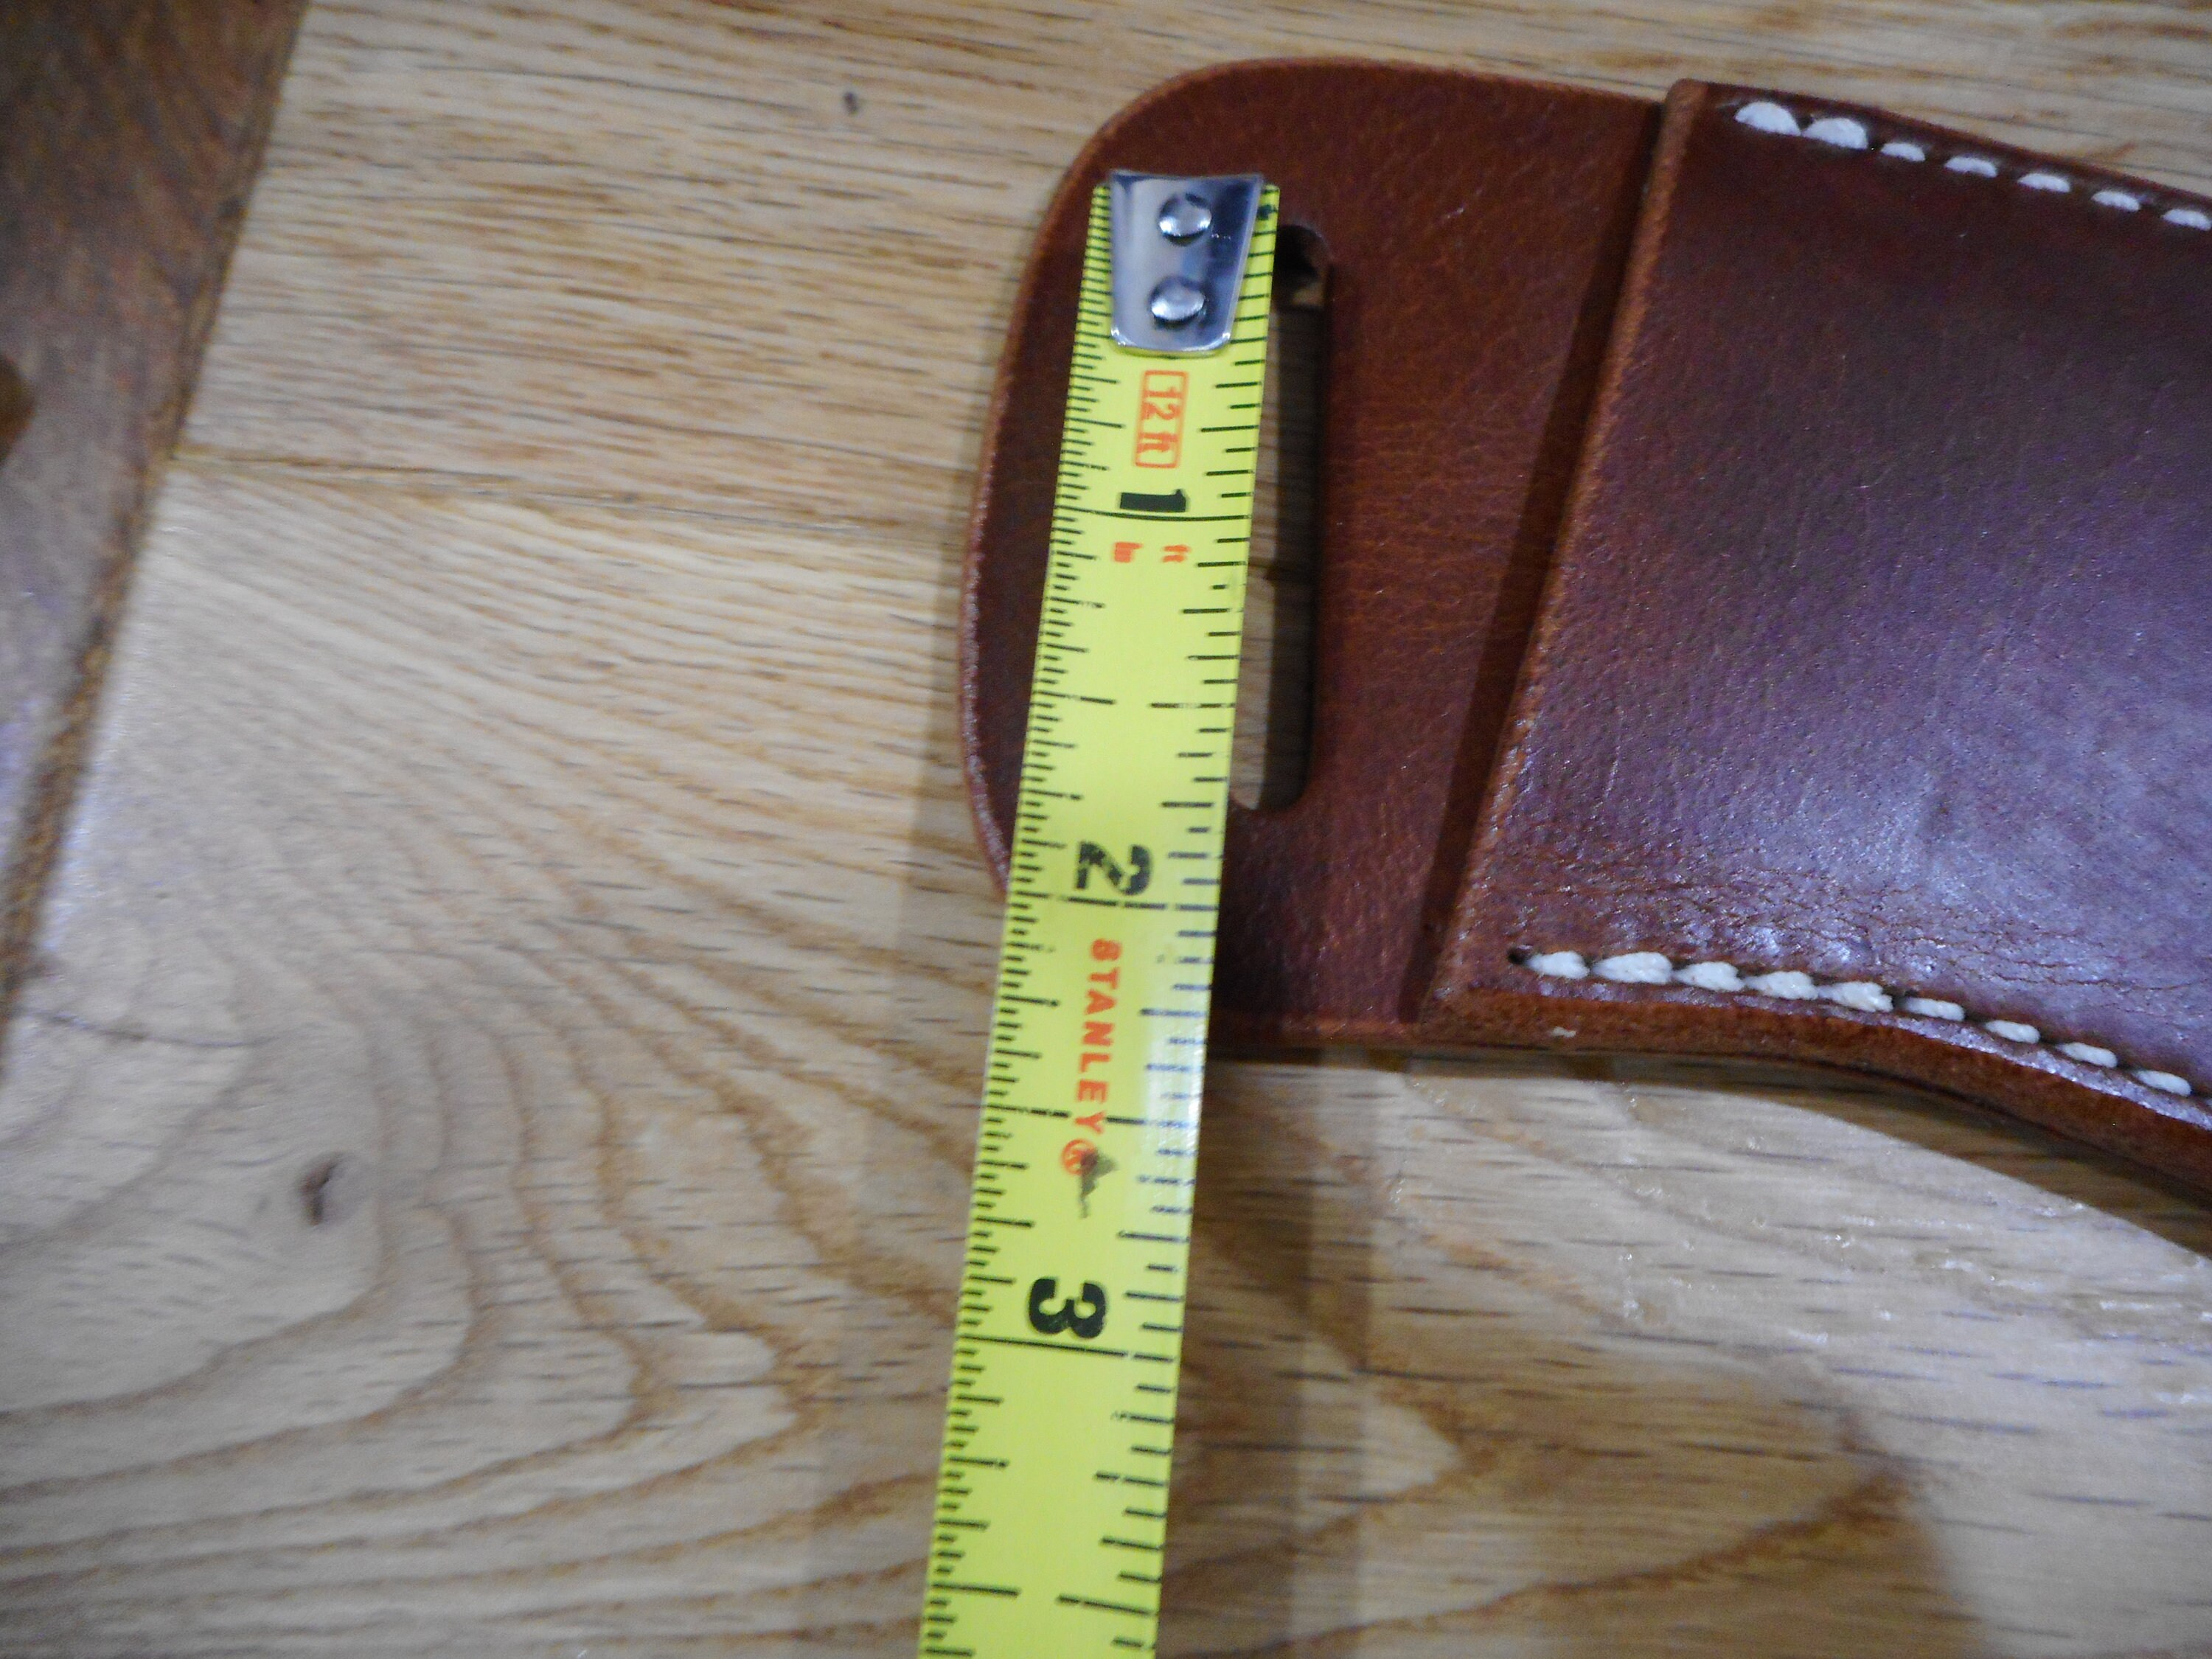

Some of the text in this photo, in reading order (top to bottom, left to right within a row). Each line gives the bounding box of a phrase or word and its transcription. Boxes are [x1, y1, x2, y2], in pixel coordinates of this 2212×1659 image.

[1141, 386, 1184, 421] 12
[1119, 488, 1191, 514] 1
[1073, 840, 1153, 897] 2
[1073, 937, 1123, 1135] STANLEY
[1028, 1276, 1107, 1340] 3
